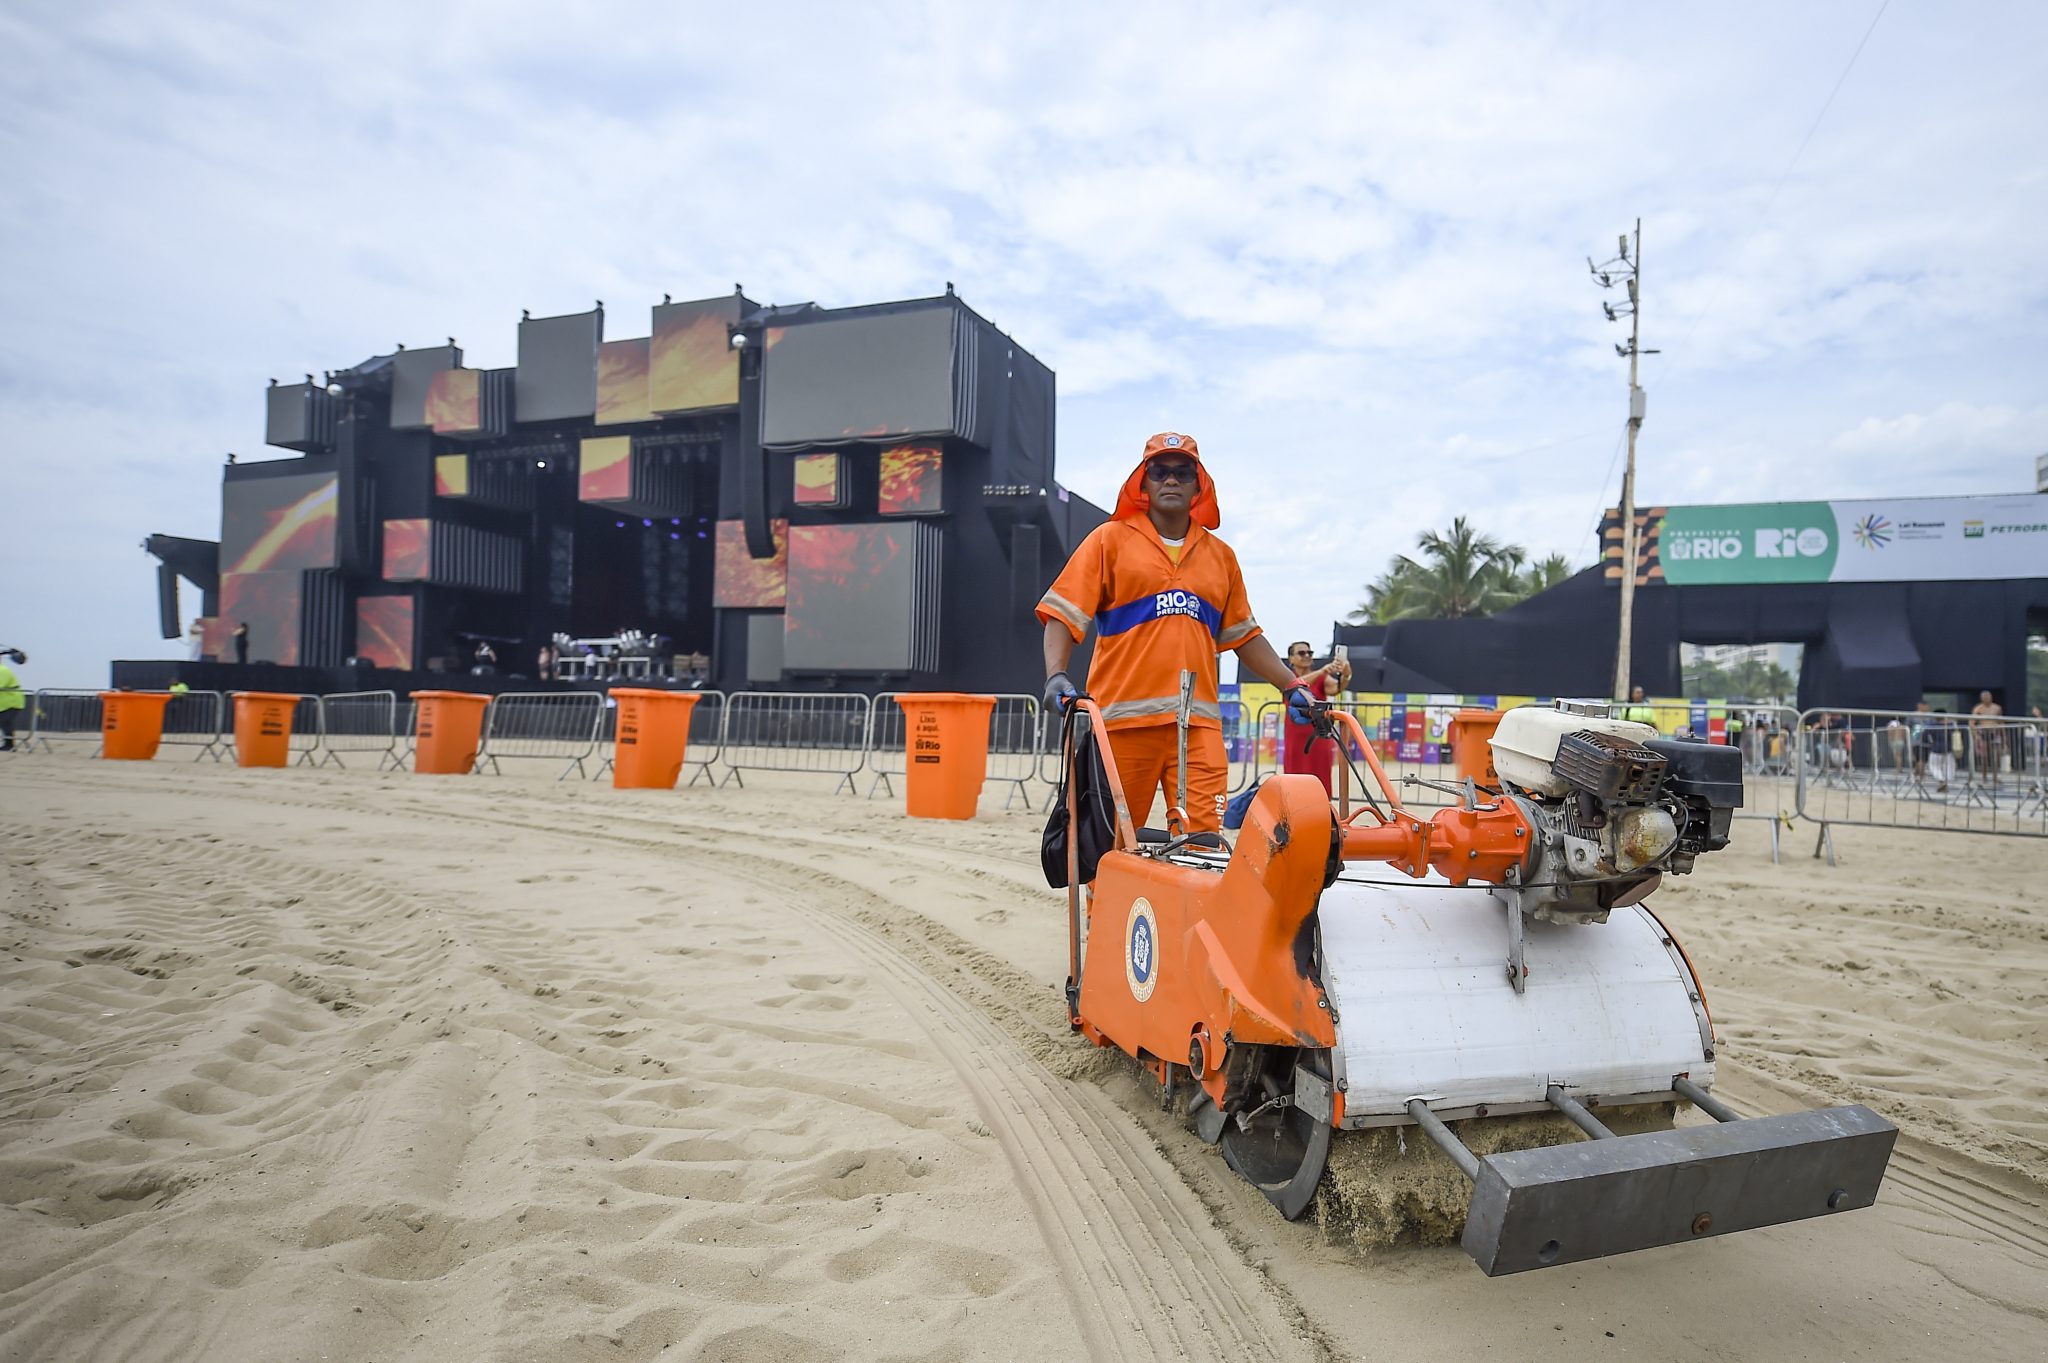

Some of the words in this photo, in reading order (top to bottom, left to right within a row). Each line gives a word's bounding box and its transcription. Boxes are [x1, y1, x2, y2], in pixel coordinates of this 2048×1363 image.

[1693, 537, 1742, 559] RIO
[1156, 591, 1187, 610] RIO
[920, 715, 936, 723] Lixo
[925, 741, 940, 750] Rio
